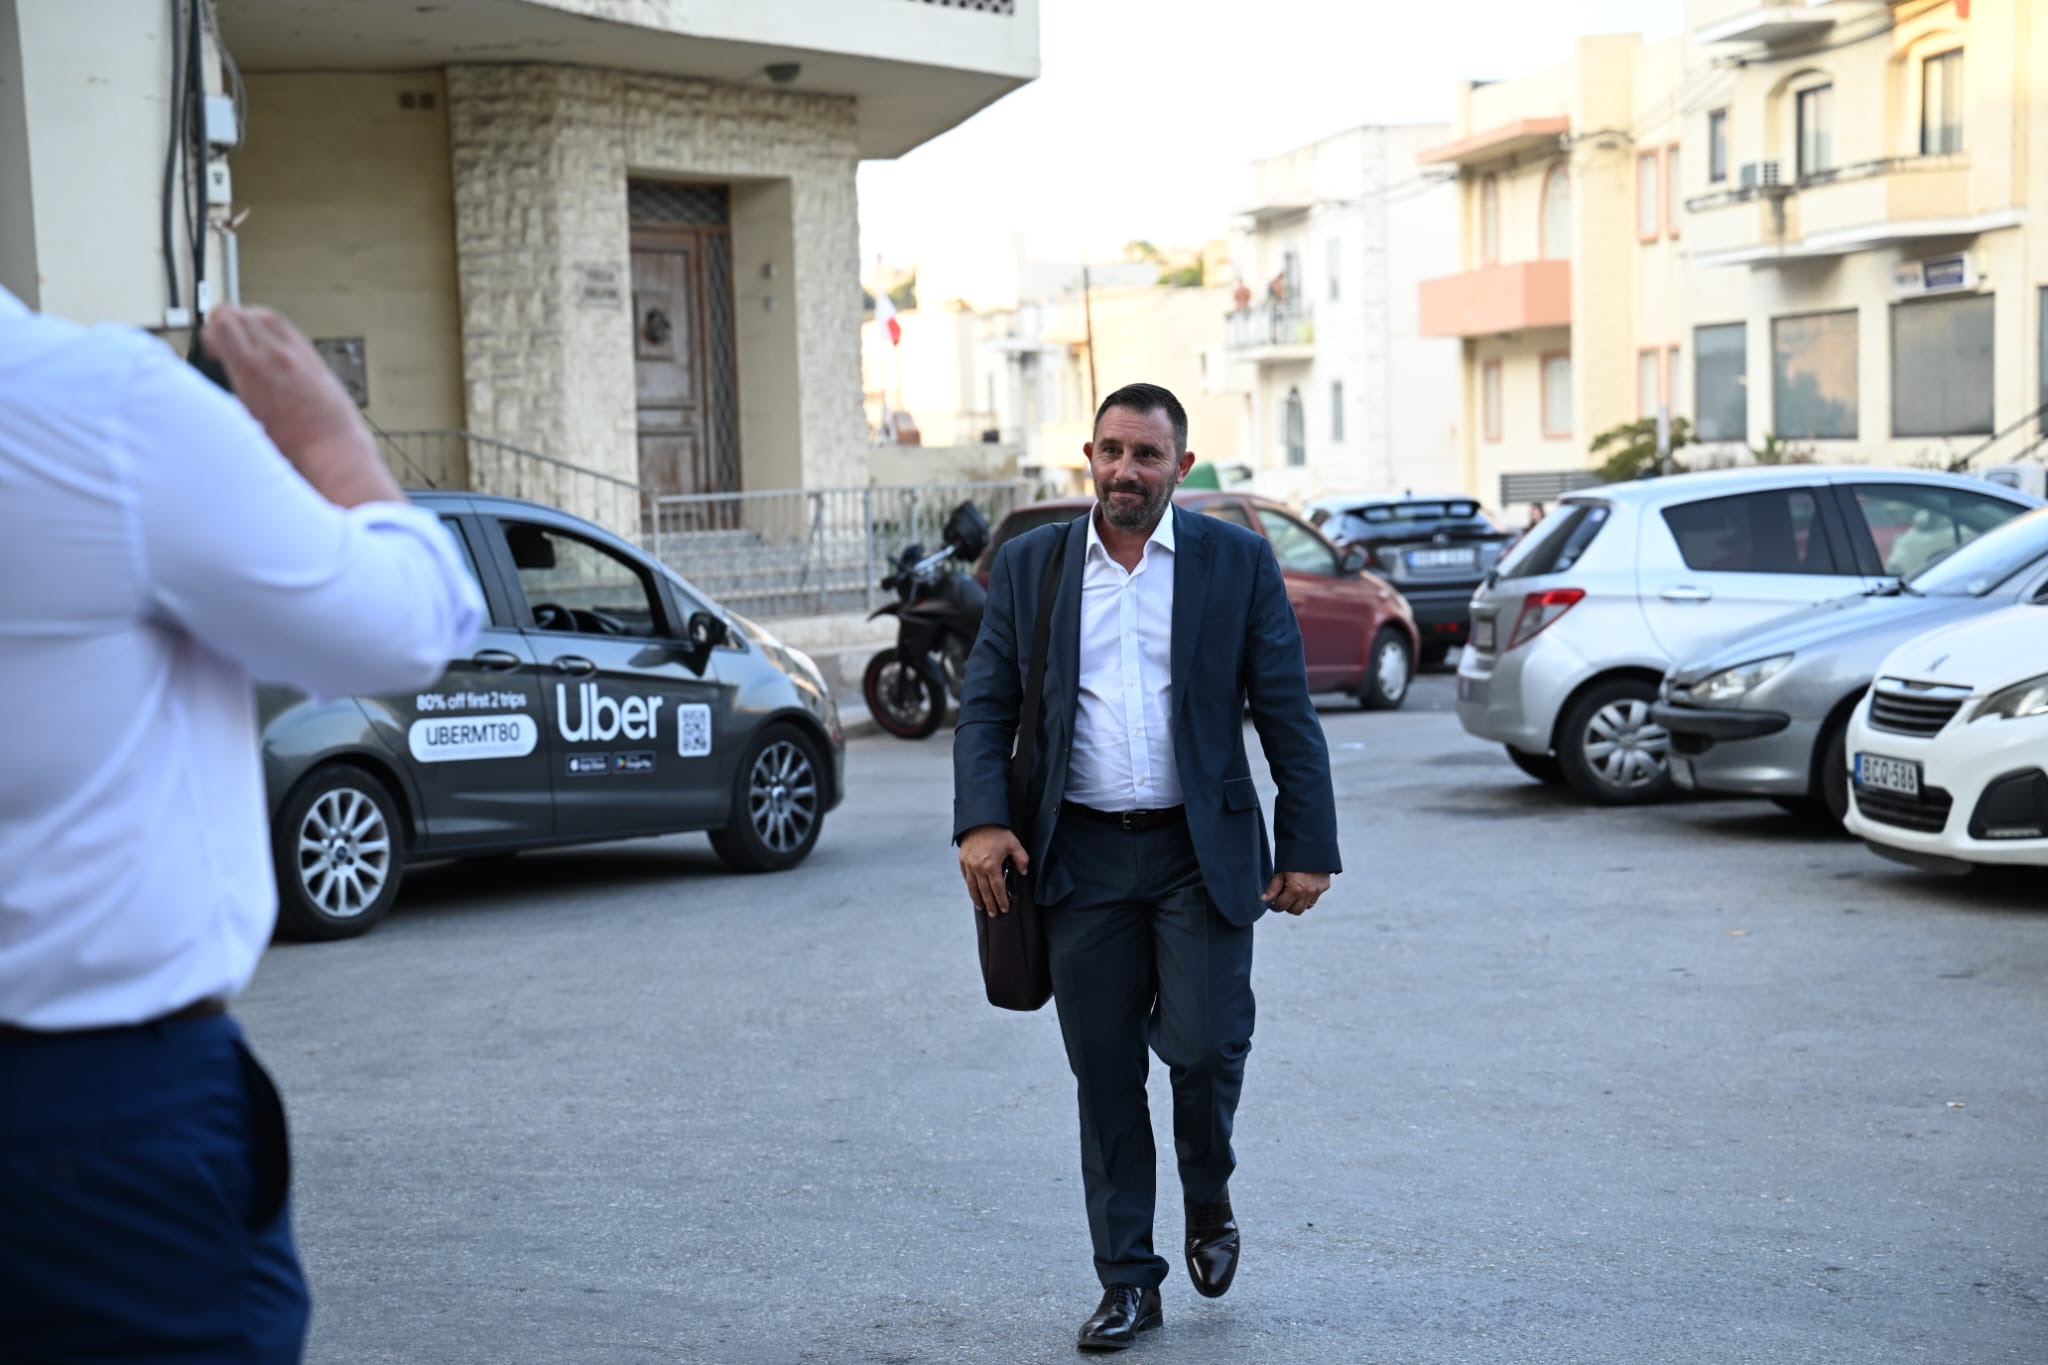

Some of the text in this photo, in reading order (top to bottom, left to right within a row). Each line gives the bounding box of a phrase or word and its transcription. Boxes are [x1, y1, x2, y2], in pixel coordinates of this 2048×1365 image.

[416, 691, 527, 711] 80% off first 2 trips
[556, 681, 664, 743] Uber
[425, 722, 520, 746] UBERMT80
